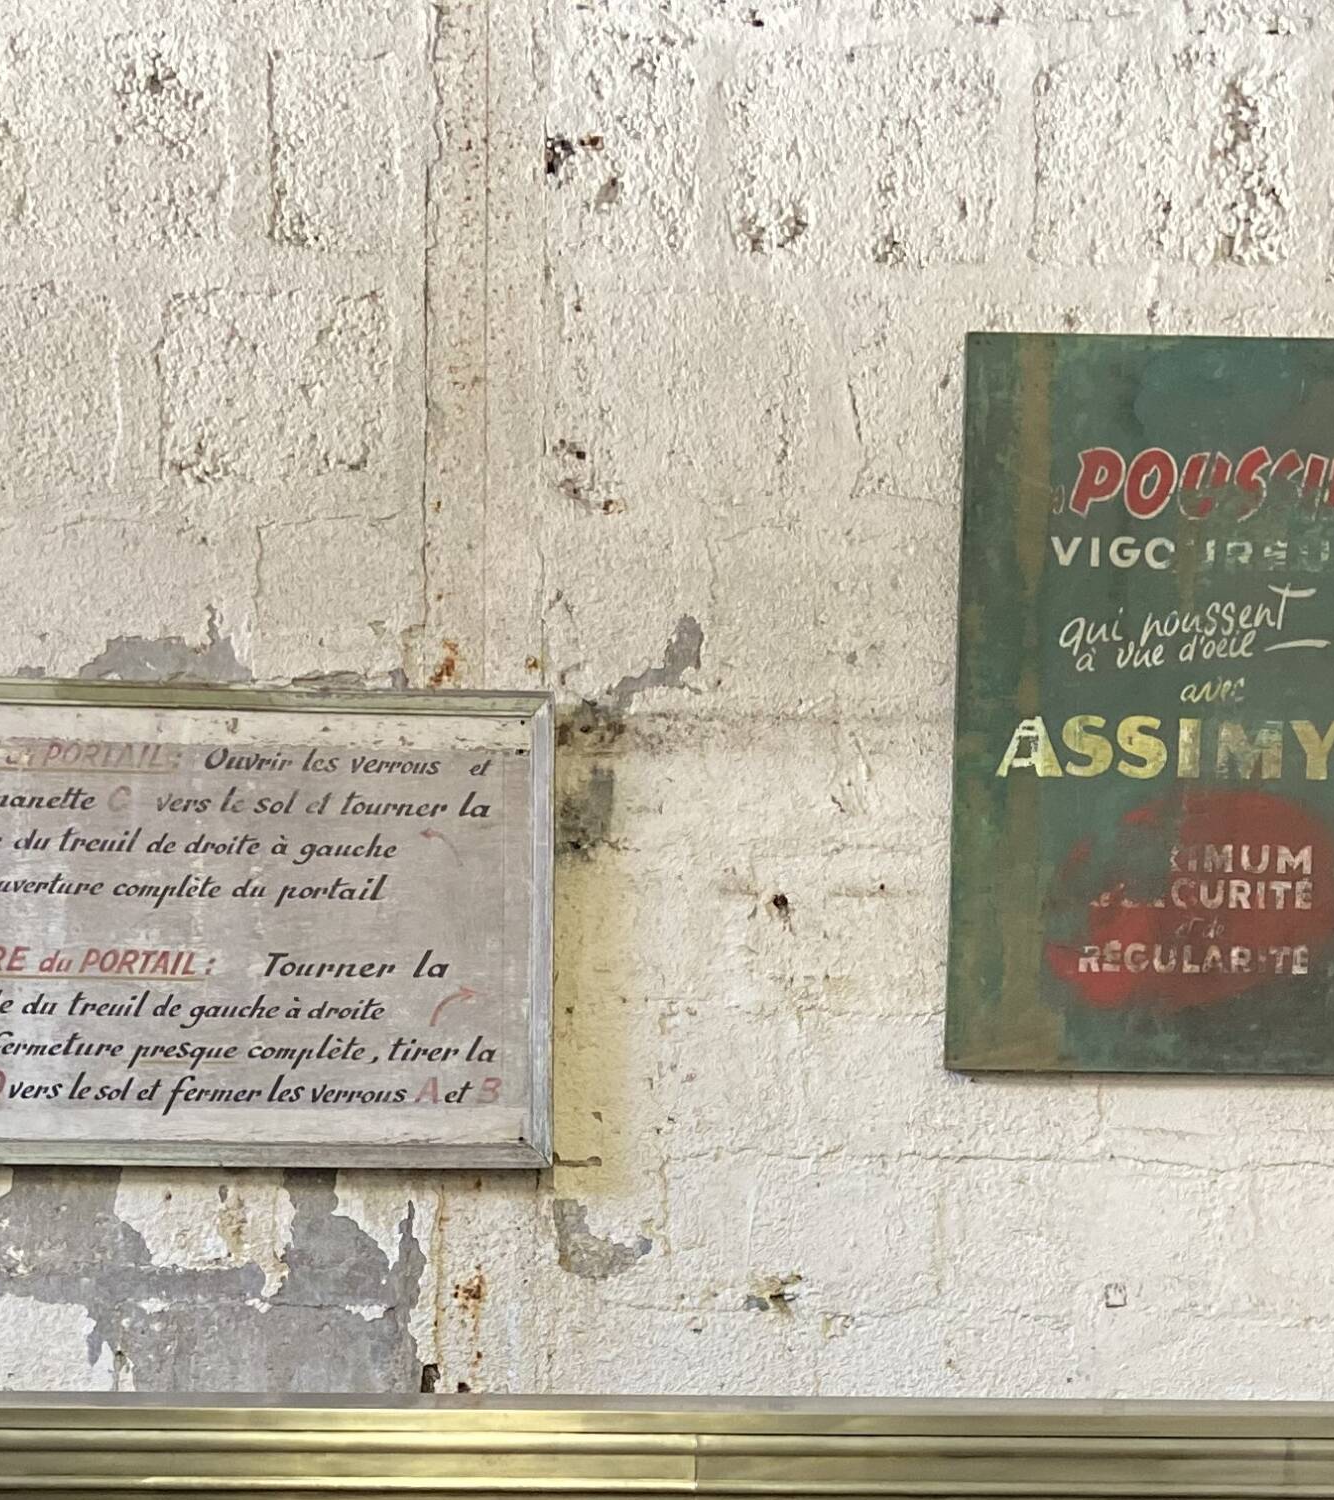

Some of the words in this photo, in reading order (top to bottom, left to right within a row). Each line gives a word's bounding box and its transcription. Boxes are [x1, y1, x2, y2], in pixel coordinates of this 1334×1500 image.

[1058, 608, 1123, 659] qui
[1139, 582, 1317, 647] poussent
[1075, 653, 1095, 672] à
[1117, 640, 1165, 669] vue
[1179, 676, 1245, 702] avec
[205, 747, 293, 771] Ouvrir
[301, 748, 339, 773] les
[351, 755, 442, 776] verrous
[469, 758, 493, 777] et
[156, 795, 212, 815] vers
[220, 786, 245, 814] le
[253, 789, 299, 815] sol
[305, 792, 333, 815] et
[340, 790, 449, 818] tourner
[458, 791, 492, 818] la
[13, 828, 51, 851] du
[58, 827, 143, 853] treuil
[147, 833, 178, 855] de
[184, 833, 261, 856] droite
[271, 834, 288, 856] à
[292, 833, 398, 865] gauche
[1169, 843, 1313, 875] XIMUM
[112, 872, 222, 909] complète
[232, 877, 268, 900] du
[274, 873, 389, 908] portail
[1120, 877, 1313, 910] CURITÉ
[38, 947, 73, 973] du
[263, 952, 396, 979] Tourner
[412, 950, 450, 979] la
[1078, 940, 1310, 976] RÉGULARTÉ
[21, 993, 58, 1017] du
[67, 991, 152, 1018] treuil
[152, 993, 182, 1018] de
[180, 993, 281, 1030] gauche
[285, 996, 302, 1020] à
[307, 999, 386, 1021] droite
[127, 1041, 238, 1070] presque
[386, 1037, 460, 1063] tirer
[465, 1036, 496, 1064] la
[9, 1081, 64, 1100] vers
[68, 1071, 91, 1101] le
[94, 1077, 130, 1101] sol
[137, 1079, 162, 1102] et
[162, 1074, 263, 1116] fermer
[268, 1074, 305, 1104] les
[311, 1082, 408, 1105] verrous
[415, 1076, 440, 1104] A
[444, 1080, 472, 1105] et
